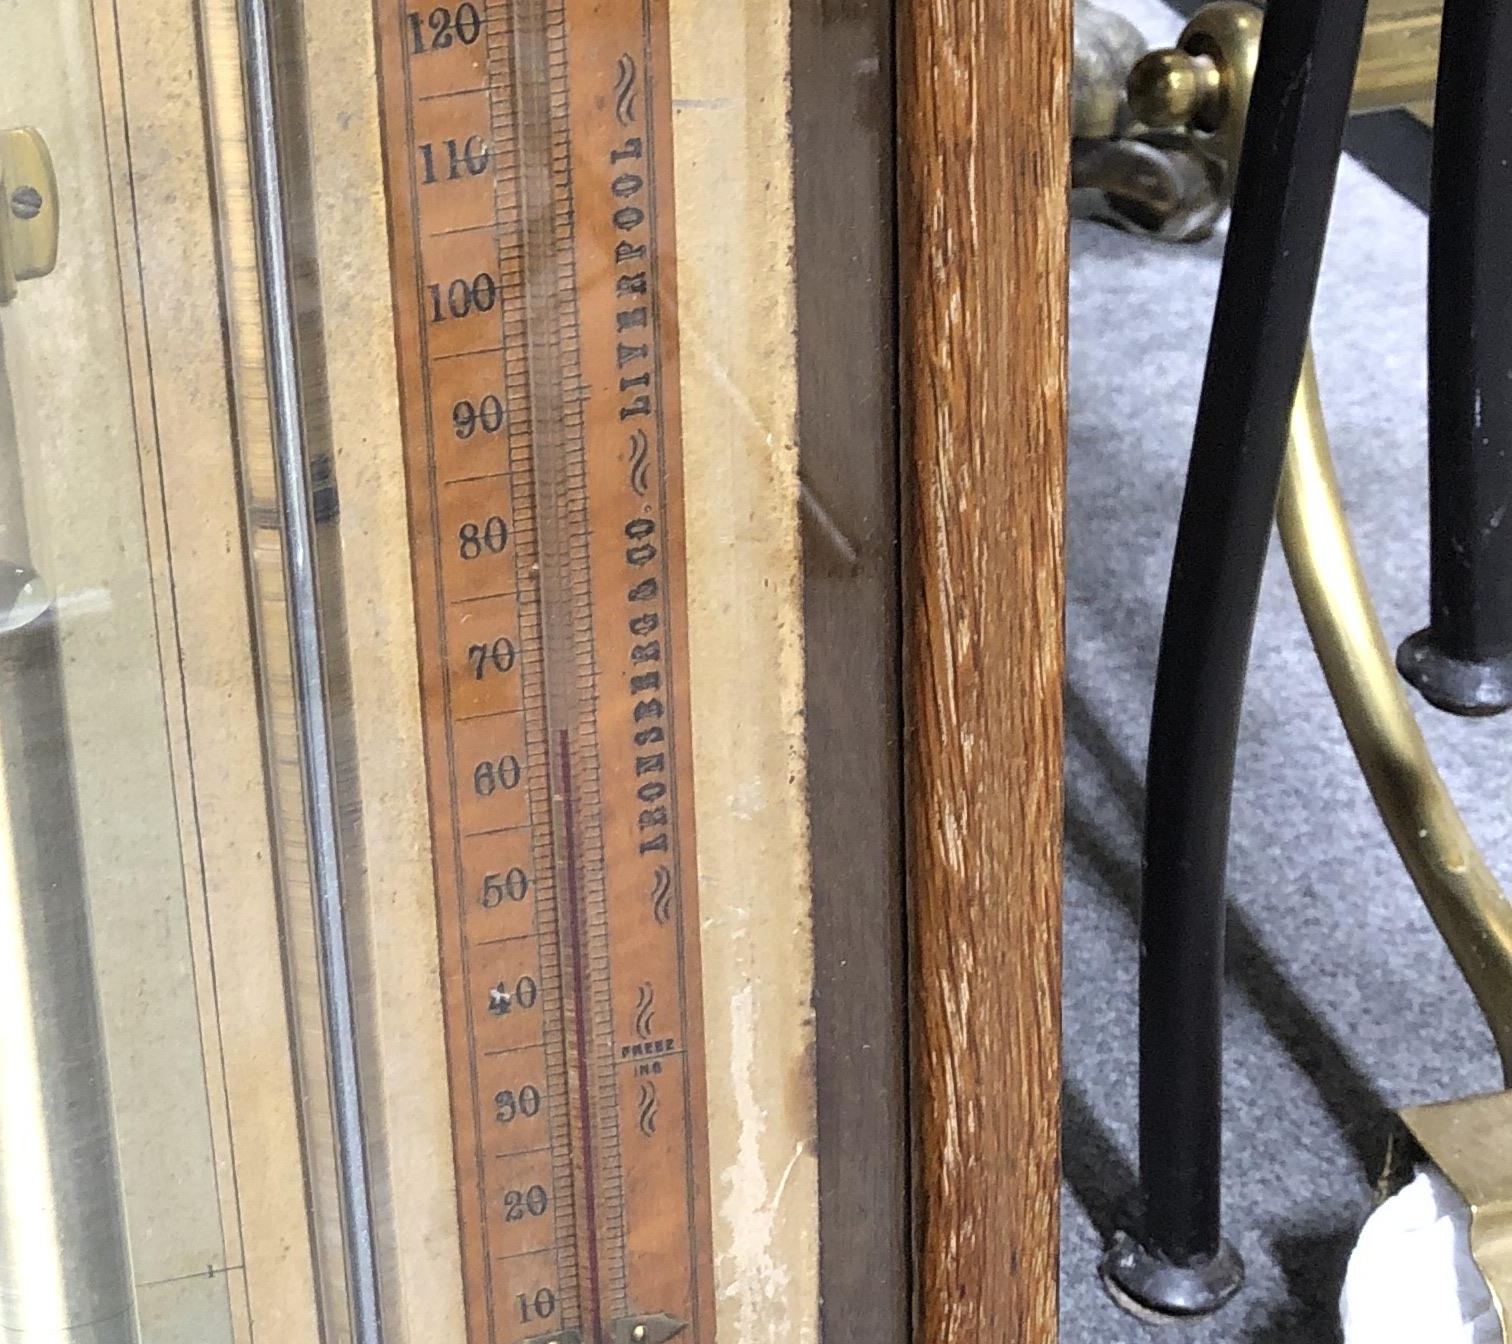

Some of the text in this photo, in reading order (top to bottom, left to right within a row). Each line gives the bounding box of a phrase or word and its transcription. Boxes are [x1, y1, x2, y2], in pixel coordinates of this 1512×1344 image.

[408, 2, 481, 54] 120
[419, 135, 488, 185] 110
[428, 272, 496, 323] 100
[610, 136, 651, 422] LIVERPOOL
[452, 394, 504, 439] 90
[459, 516, 508, 560] 80
[628, 576, 659, 603] &
[468, 637, 516, 681] 70
[629, 612, 670, 856] ARONSBERG
[473, 754, 522, 797] 60
[482, 867, 529, 909] 50
[488, 975, 538, 1017] 40
[494, 1083, 541, 1122] 30
[504, 1184, 549, 1222] 20
[516, 1287, 556, 1323] 10
